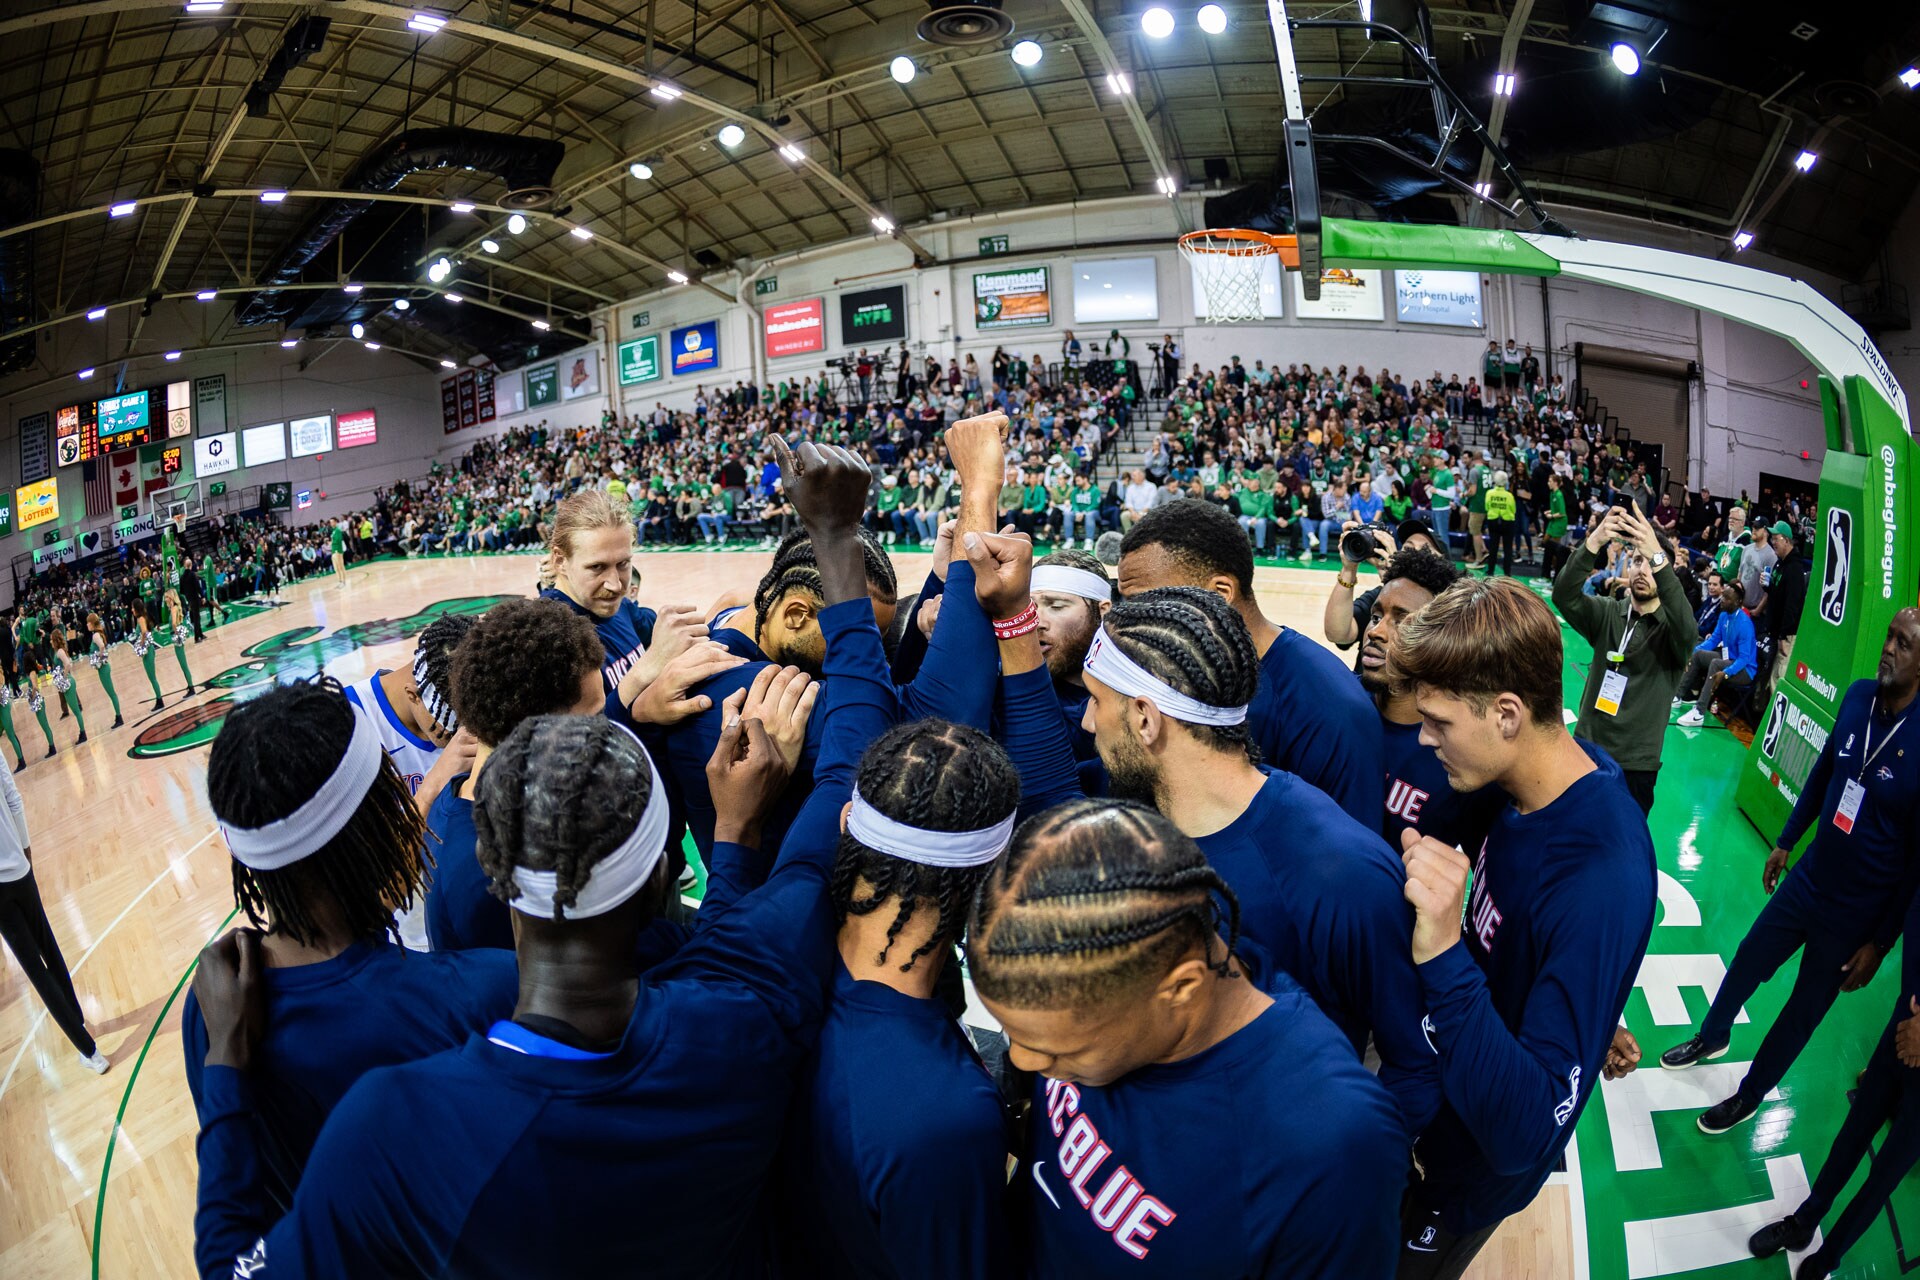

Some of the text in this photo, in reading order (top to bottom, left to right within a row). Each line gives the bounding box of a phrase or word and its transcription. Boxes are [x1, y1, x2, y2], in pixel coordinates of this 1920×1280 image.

[993, 242, 1006, 252] 12
[976, 268, 1045, 287] Hammond
[1400, 288, 1475, 303] Northern Light
[853, 308, 892, 327] HYPE
[1860, 336, 1899, 398] SPALDING
[301, 432, 323, 445] DINER
[164, 458, 178, 472] 24
[203, 458, 230, 470] HAWKIN
[23, 506, 54, 522] LOTTERY
[1881, 445, 1897, 599] @nbagleague
[114, 521, 153, 540] STRONG
[35, 545, 74, 565] LEWISTON
[1385, 778, 1430, 824] UE
[1058, 1113, 1177, 1260] BLUE
